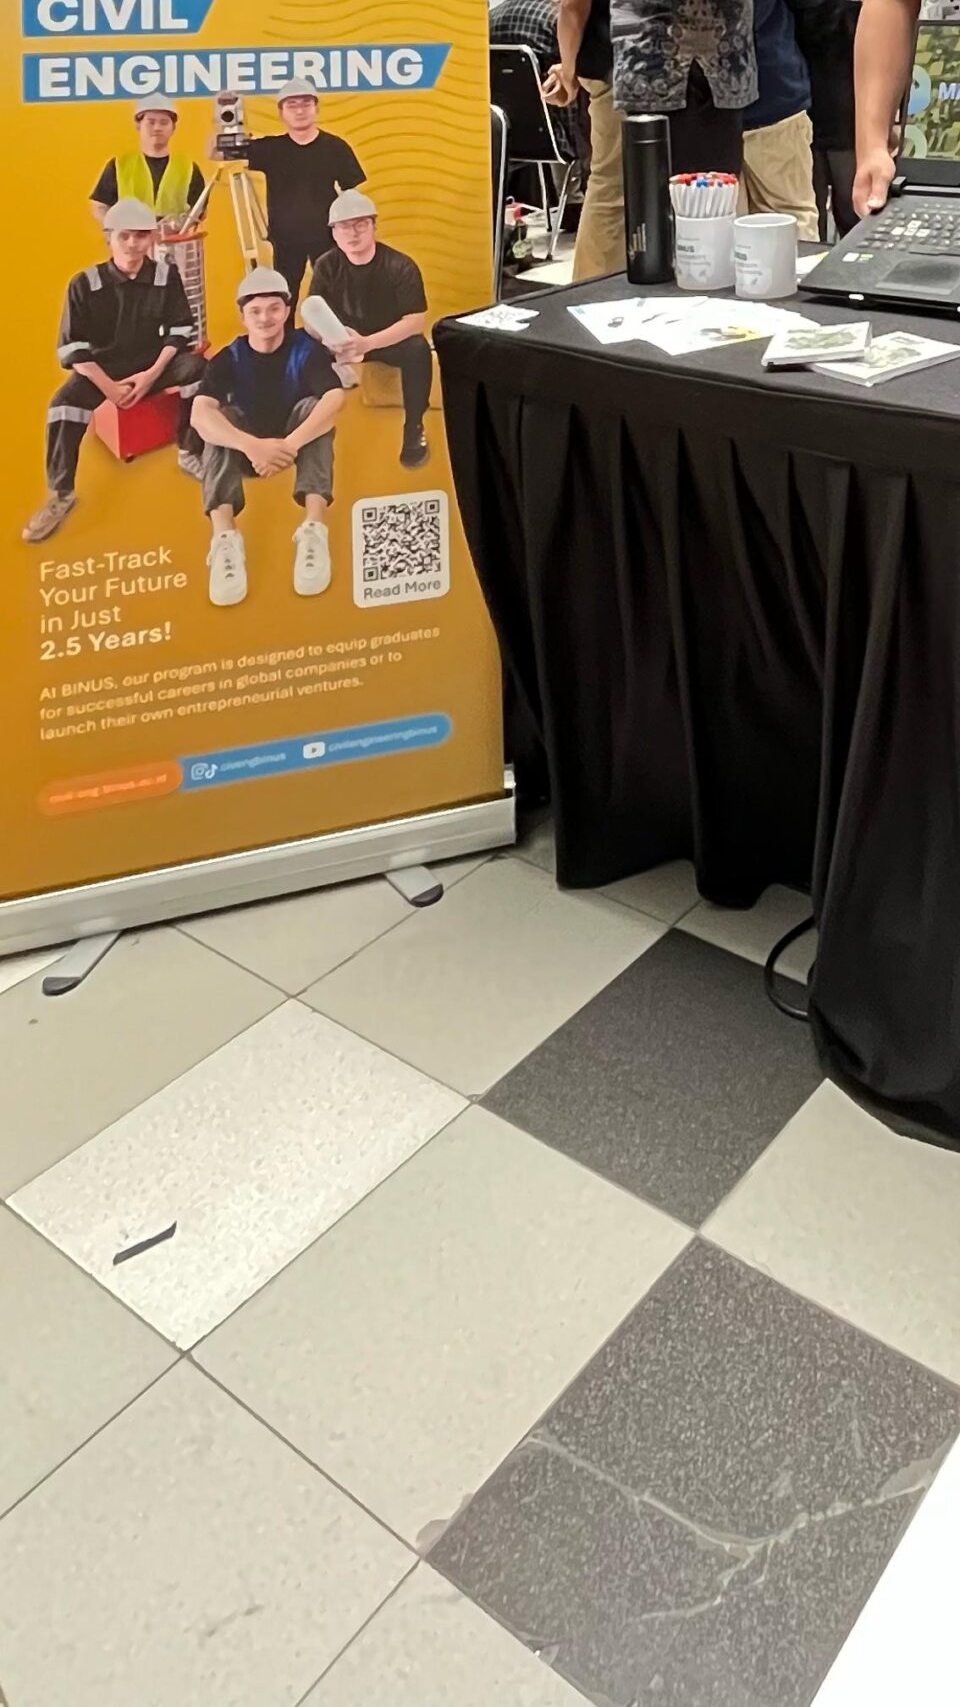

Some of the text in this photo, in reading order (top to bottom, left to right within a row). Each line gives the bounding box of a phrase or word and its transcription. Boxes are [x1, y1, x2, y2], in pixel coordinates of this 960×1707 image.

[38, 48, 423, 97] ENGINEERING
[39, 546, 173, 582] Fast-Track
[39, 570, 188, 608] Your Future
[363, 578, 442, 601] Read More
[39, 605, 122, 636] in Just
[39, 621, 172, 661] 2.5 Years!
[61, 675, 119, 698] BINUS,
[122, 673, 150, 688] our
[152, 661, 218, 684] program
[220, 658, 234, 673] is
[236, 645, 306, 671] designed
[308, 643, 324, 657] to
[326, 637, 368, 656] equip
[370, 626, 441, 650] graduates
[40, 649, 403, 722] for successful careers in global companies or to
[40, 675, 364, 741] launch their own entrepreneurial ventures.
